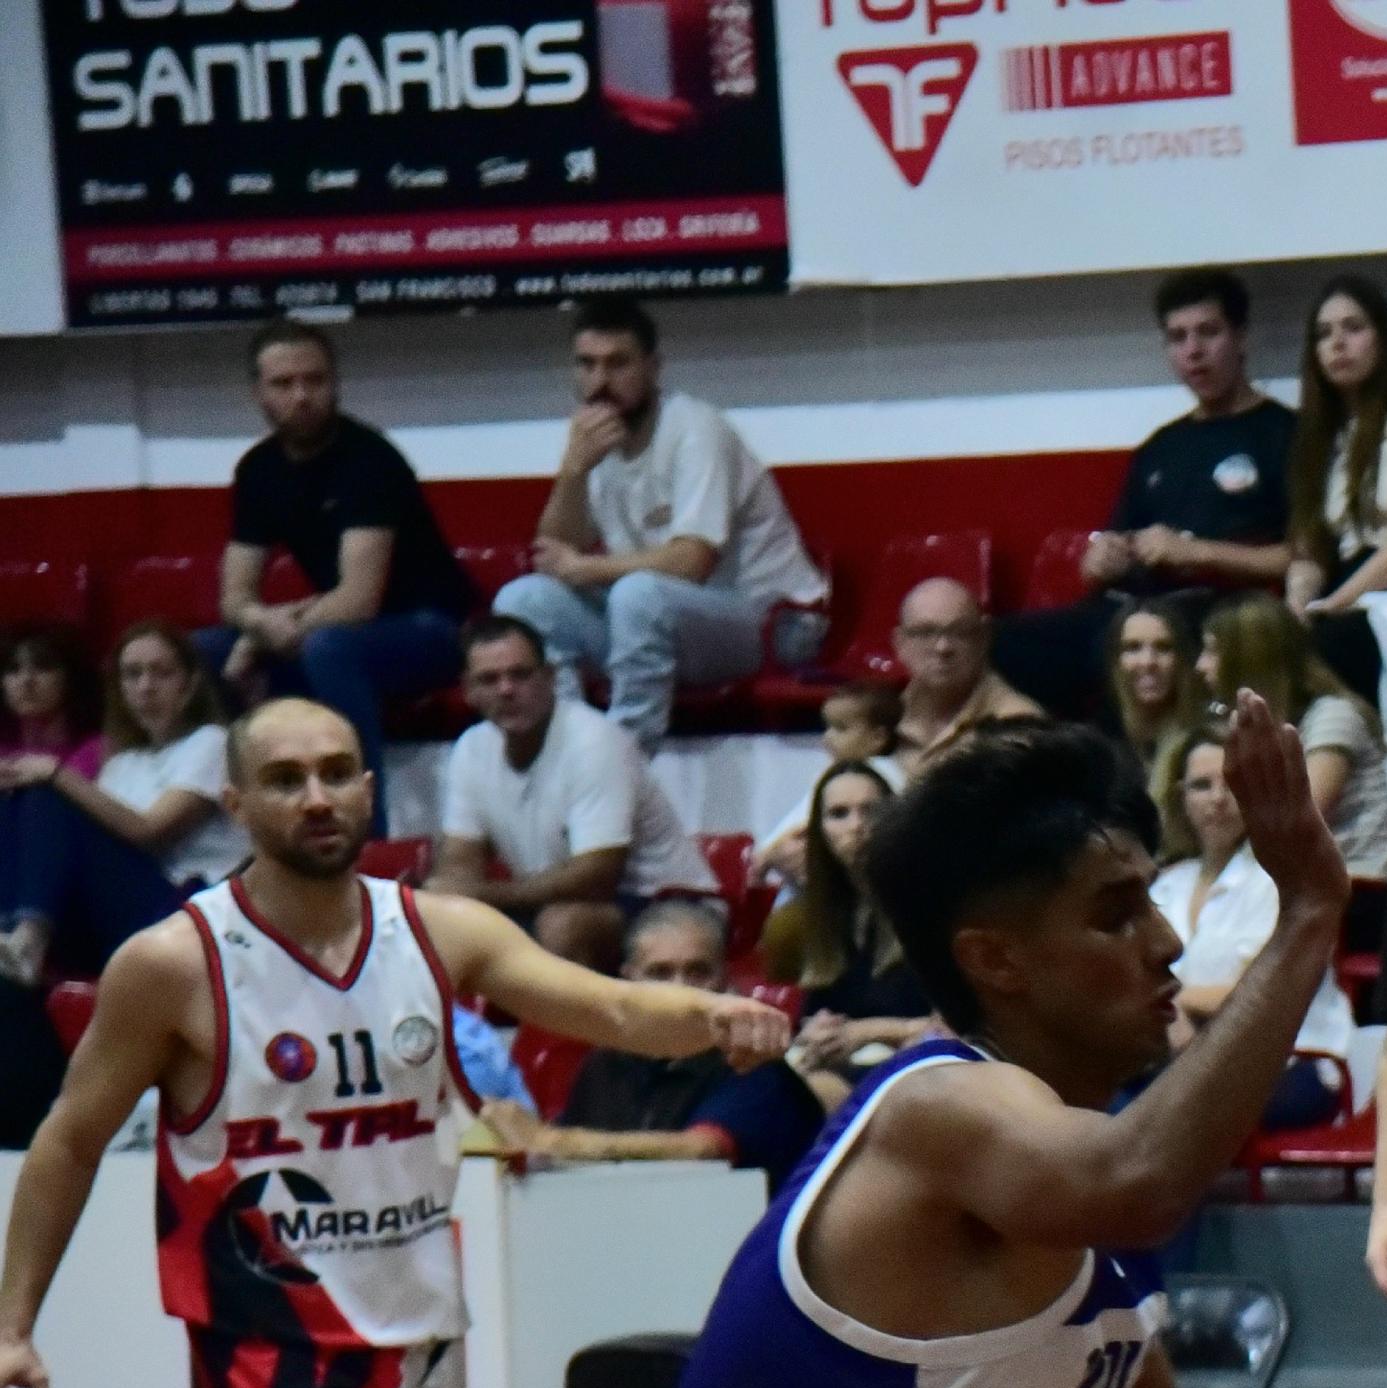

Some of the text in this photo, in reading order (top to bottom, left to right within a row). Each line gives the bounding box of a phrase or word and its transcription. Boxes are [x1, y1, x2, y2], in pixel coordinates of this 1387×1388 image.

[72, 20, 590, 132] SANITARIOS
[1070, 42, 1222, 97] ADVANCE
[1004, 126, 1247, 171] PISOS FLOTANTES
[327, 1029, 384, 1097] 11
[224, 1089, 446, 1159] EL TAL
